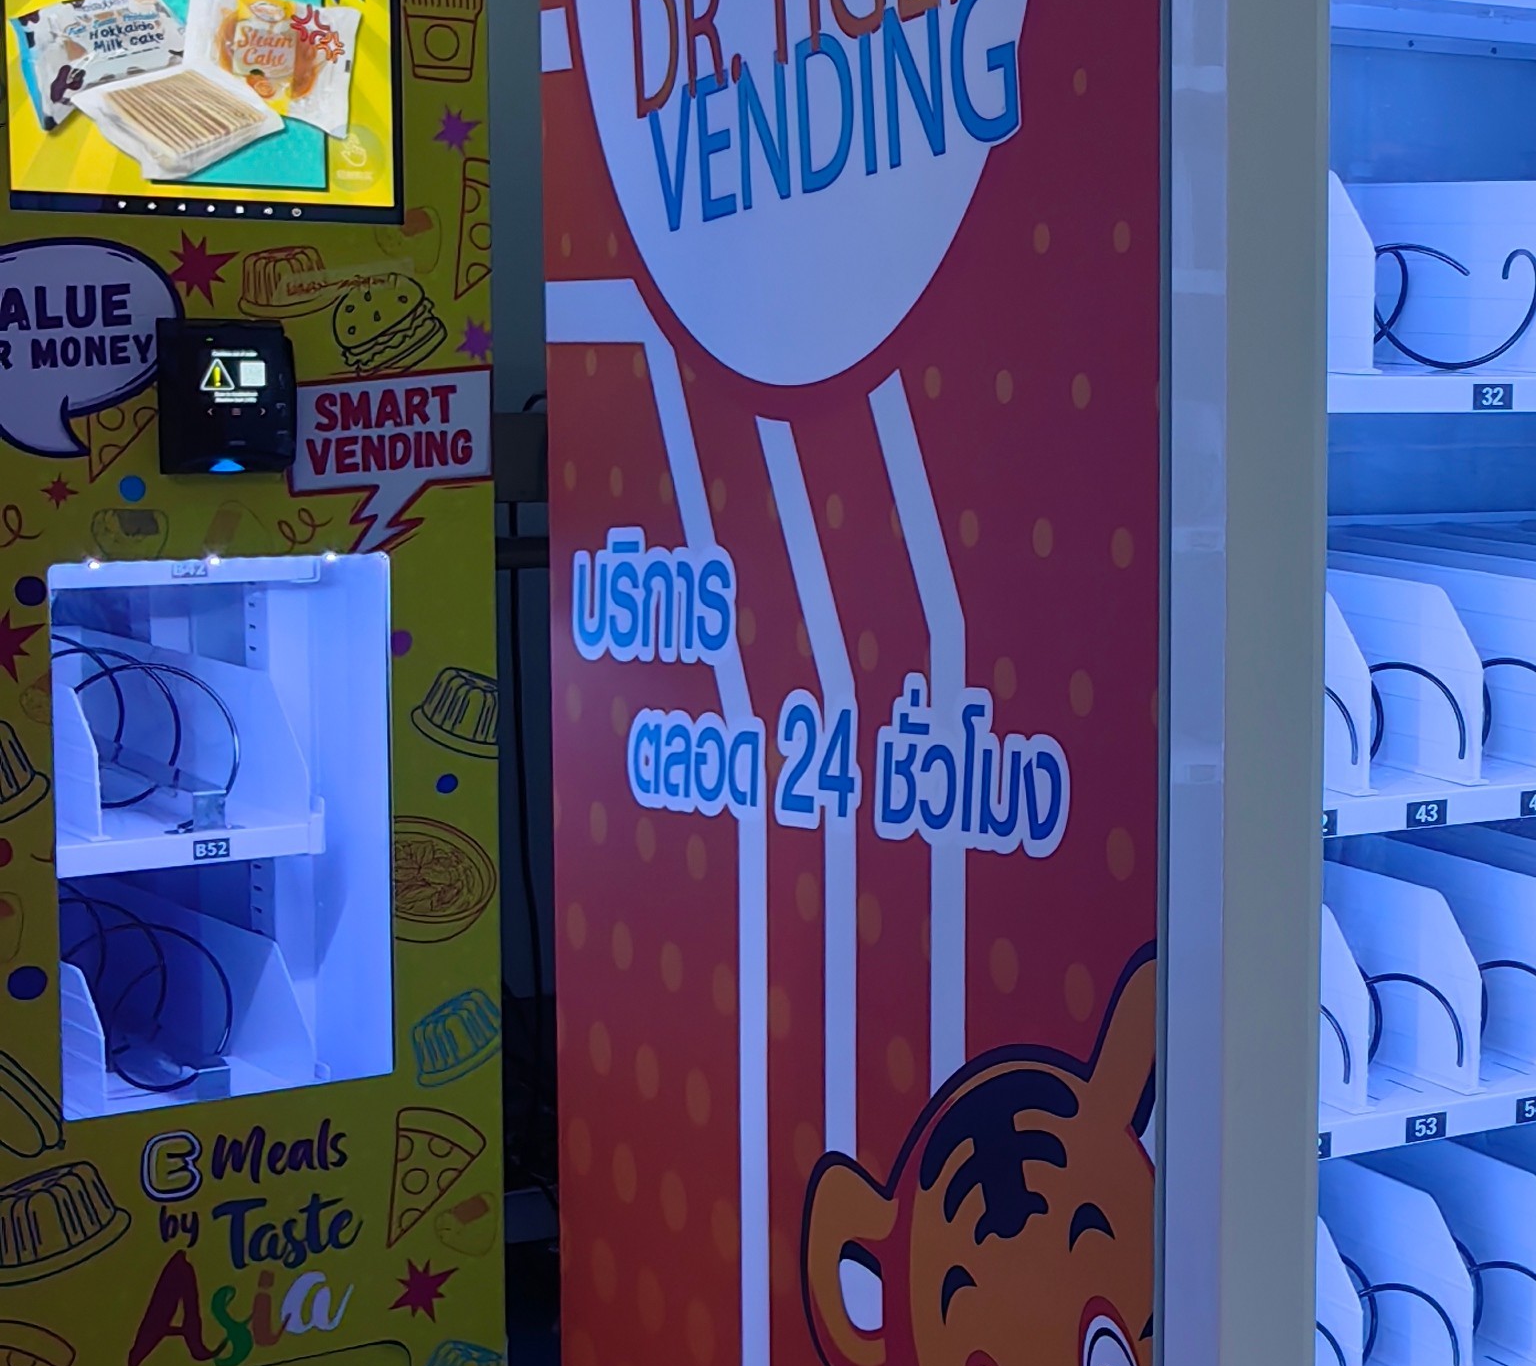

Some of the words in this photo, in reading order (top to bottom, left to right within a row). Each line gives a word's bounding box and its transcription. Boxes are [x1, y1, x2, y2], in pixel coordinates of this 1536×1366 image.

[89, 21, 155, 40] Hokkaido
[93, 38, 128, 52] Milk
[129, 32, 165, 46] cake
[237, 26, 292, 48] Steam
[243, 47, 285, 67] Cake
[0, 283, 132, 331] ALUE
[31, 334, 154, 369] MONEY
[314, 385, 457, 432] SMART
[1481, 386, 1504, 406] 32
[305, 428, 473, 476] VENDING
[578, 540, 731, 652] บริการ
[633, 721, 759, 808] ตลอด
[781, 704, 855, 818] 24
[881, 688, 1062, 841] ชั่วโมง
[1415, 803, 1439, 823] 43
[195, 841, 228, 858] B52
[1414, 1117, 1438, 1137] 53
[211, 1119, 349, 1184] Meals
[158, 1205, 200, 1248] by
[211, 1193, 364, 1270] Taste
